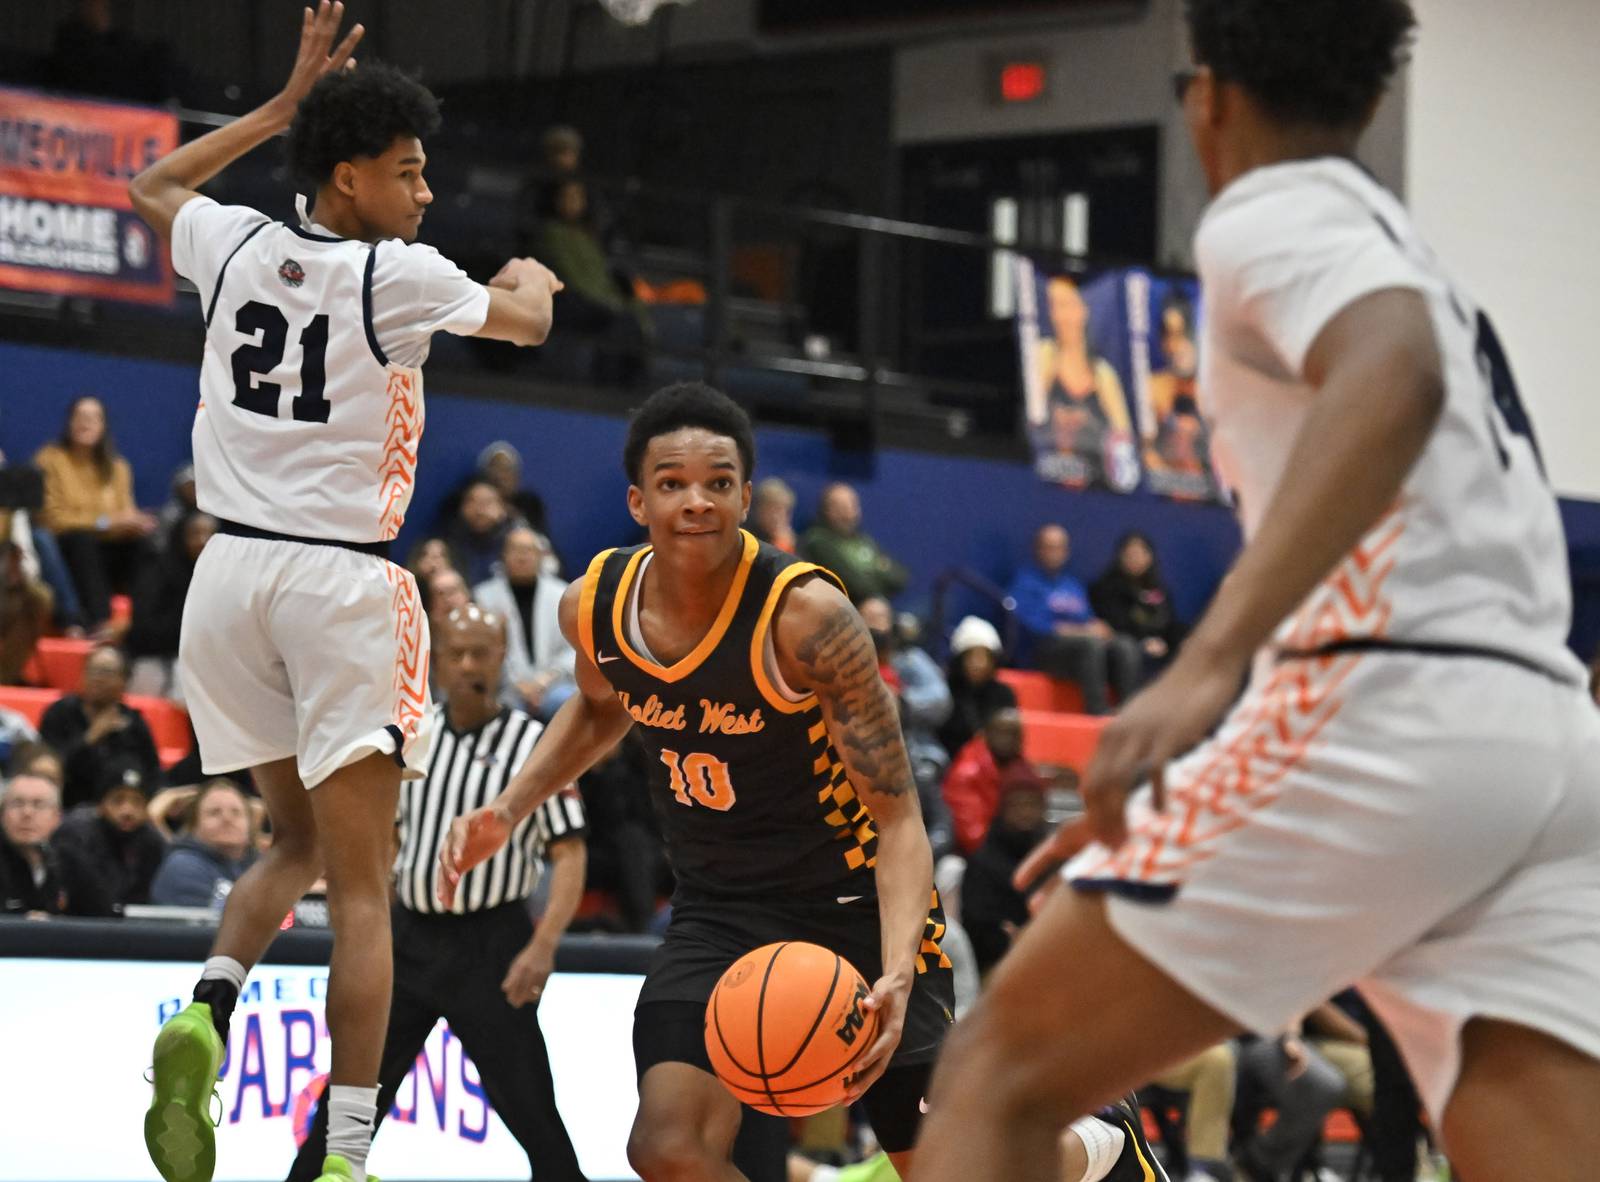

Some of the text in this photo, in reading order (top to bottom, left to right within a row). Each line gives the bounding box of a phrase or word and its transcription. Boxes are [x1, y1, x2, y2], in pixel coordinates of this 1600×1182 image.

[0, 197, 117, 251] HOME
[231, 300, 331, 424] 21
[699, 698, 765, 735] West
[660, 748, 737, 811] 10
